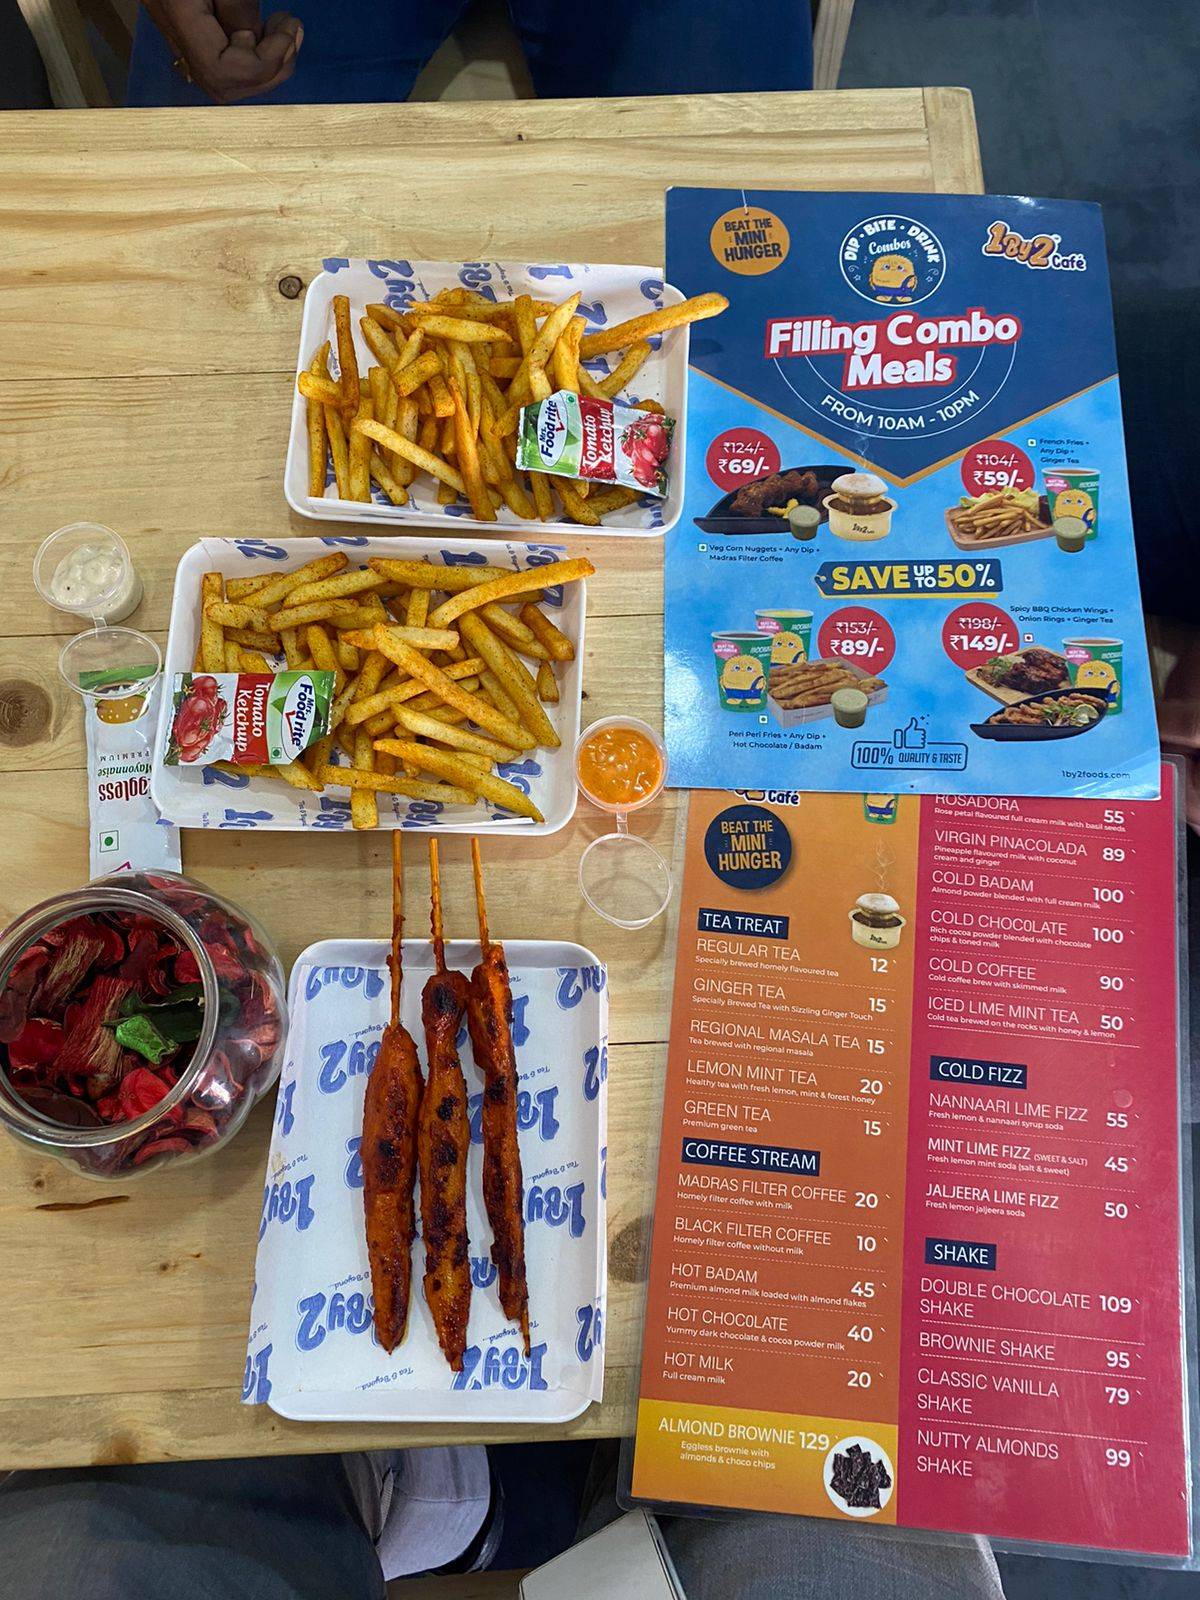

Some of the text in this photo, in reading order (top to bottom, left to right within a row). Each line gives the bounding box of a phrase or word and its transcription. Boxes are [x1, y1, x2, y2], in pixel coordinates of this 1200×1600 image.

[724, 218, 772, 232] BEAT THE
[734, 230, 767, 246] MINI
[724, 244, 782, 262] HUNGER
[844, 219, 940, 263] DIP BITE DRINK
[868, 239, 911, 256] Combos
[1052, 255, 1084, 268] Café
[770, 311, 1017, 355] Filling Combo
[847, 351, 952, 386] Meals
[821, 394, 873, 427] FROM
[878, 416, 925, 430] 10AM
[938, 390, 980, 421] 10PM
[581, 414, 595, 468] Tomato
[718, 457, 770, 475] ₹69/-
[974, 470, 1024, 487] ₹59/-
[710, 544, 724, 553] Veg
[745, 545, 777, 554] Nuggets
[785, 546, 799, 554] Any
[832, 563, 995, 590] SAVE UP TO 50%
[831, 638, 884, 657] ₹89/-
[950, 634, 1014, 653] ₹149/-
[238, 689, 252, 752] Ketchup
[252, 682, 270, 738] Tomato
[856, 746, 962, 765] 100% QUALITY & TASTE
[1062, 770, 1130, 780] 1by2foods.com
[98, 776, 151, 802] ggless
[768, 790, 799, 805] Café
[721, 820, 773, 834] BEAT THE
[731, 834, 766, 852] MINI
[935, 830, 1125, 862] VIRGIN PINACOLADA 89
[719, 851, 782, 871] HUNGER
[703, 913, 783, 934] TEA TREAT
[695, 956, 729, 967] Specially
[729, 959, 758, 968] brewed
[759, 963, 789, 973] homely
[789, 965, 825, 975] flavoured
[697, 939, 888, 973] REGULAR TEA 12
[929, 957, 1123, 991] COLD COFFEE 90
[929, 974, 1067, 994] Cold coffee brew with skimmed milk
[694, 978, 886, 1012] GINGER TEA 15
[928, 996, 1123, 1030] ICED LIME MINT TEA 50
[691, 1019, 885, 1054] REGIONAL MASALA TEA 15
[687, 1059, 883, 1094] LEMON MINT TEA 20
[939, 1061, 1023, 1084] COLD FIZZ
[684, 1100, 881, 1135] GREEN TEA 15
[929, 1093, 1128, 1128] NANNAARI LIME FIZZ 55
[685, 1142, 816, 1170] COFFEE STREAM
[677, 1191, 793, 1210] Homely filter coffee with milk
[678, 1174, 878, 1208] MADRAS FILTER COFFEE 20
[926, 1184, 1128, 1219] JALJEERA LIME FIZZ 50
[525, 1182, 586, 1239] 1By
[926, 1201, 1025, 1217] Fresh lemon jaljeera soda
[934, 1243, 988, 1265] SHAKE
[671, 1263, 874, 1298] HOT BADAM 45
[920, 1299, 974, 1318] SHAKE
[921, 1277, 1132, 1313] DOUBLE CHOCOLATE 109
[298, 1292, 376, 1352] By2
[920, 1332, 1130, 1368] BROWNIE SHAKE 95
[659, 1417, 829, 1450] ALMOND BROWNIE 129
